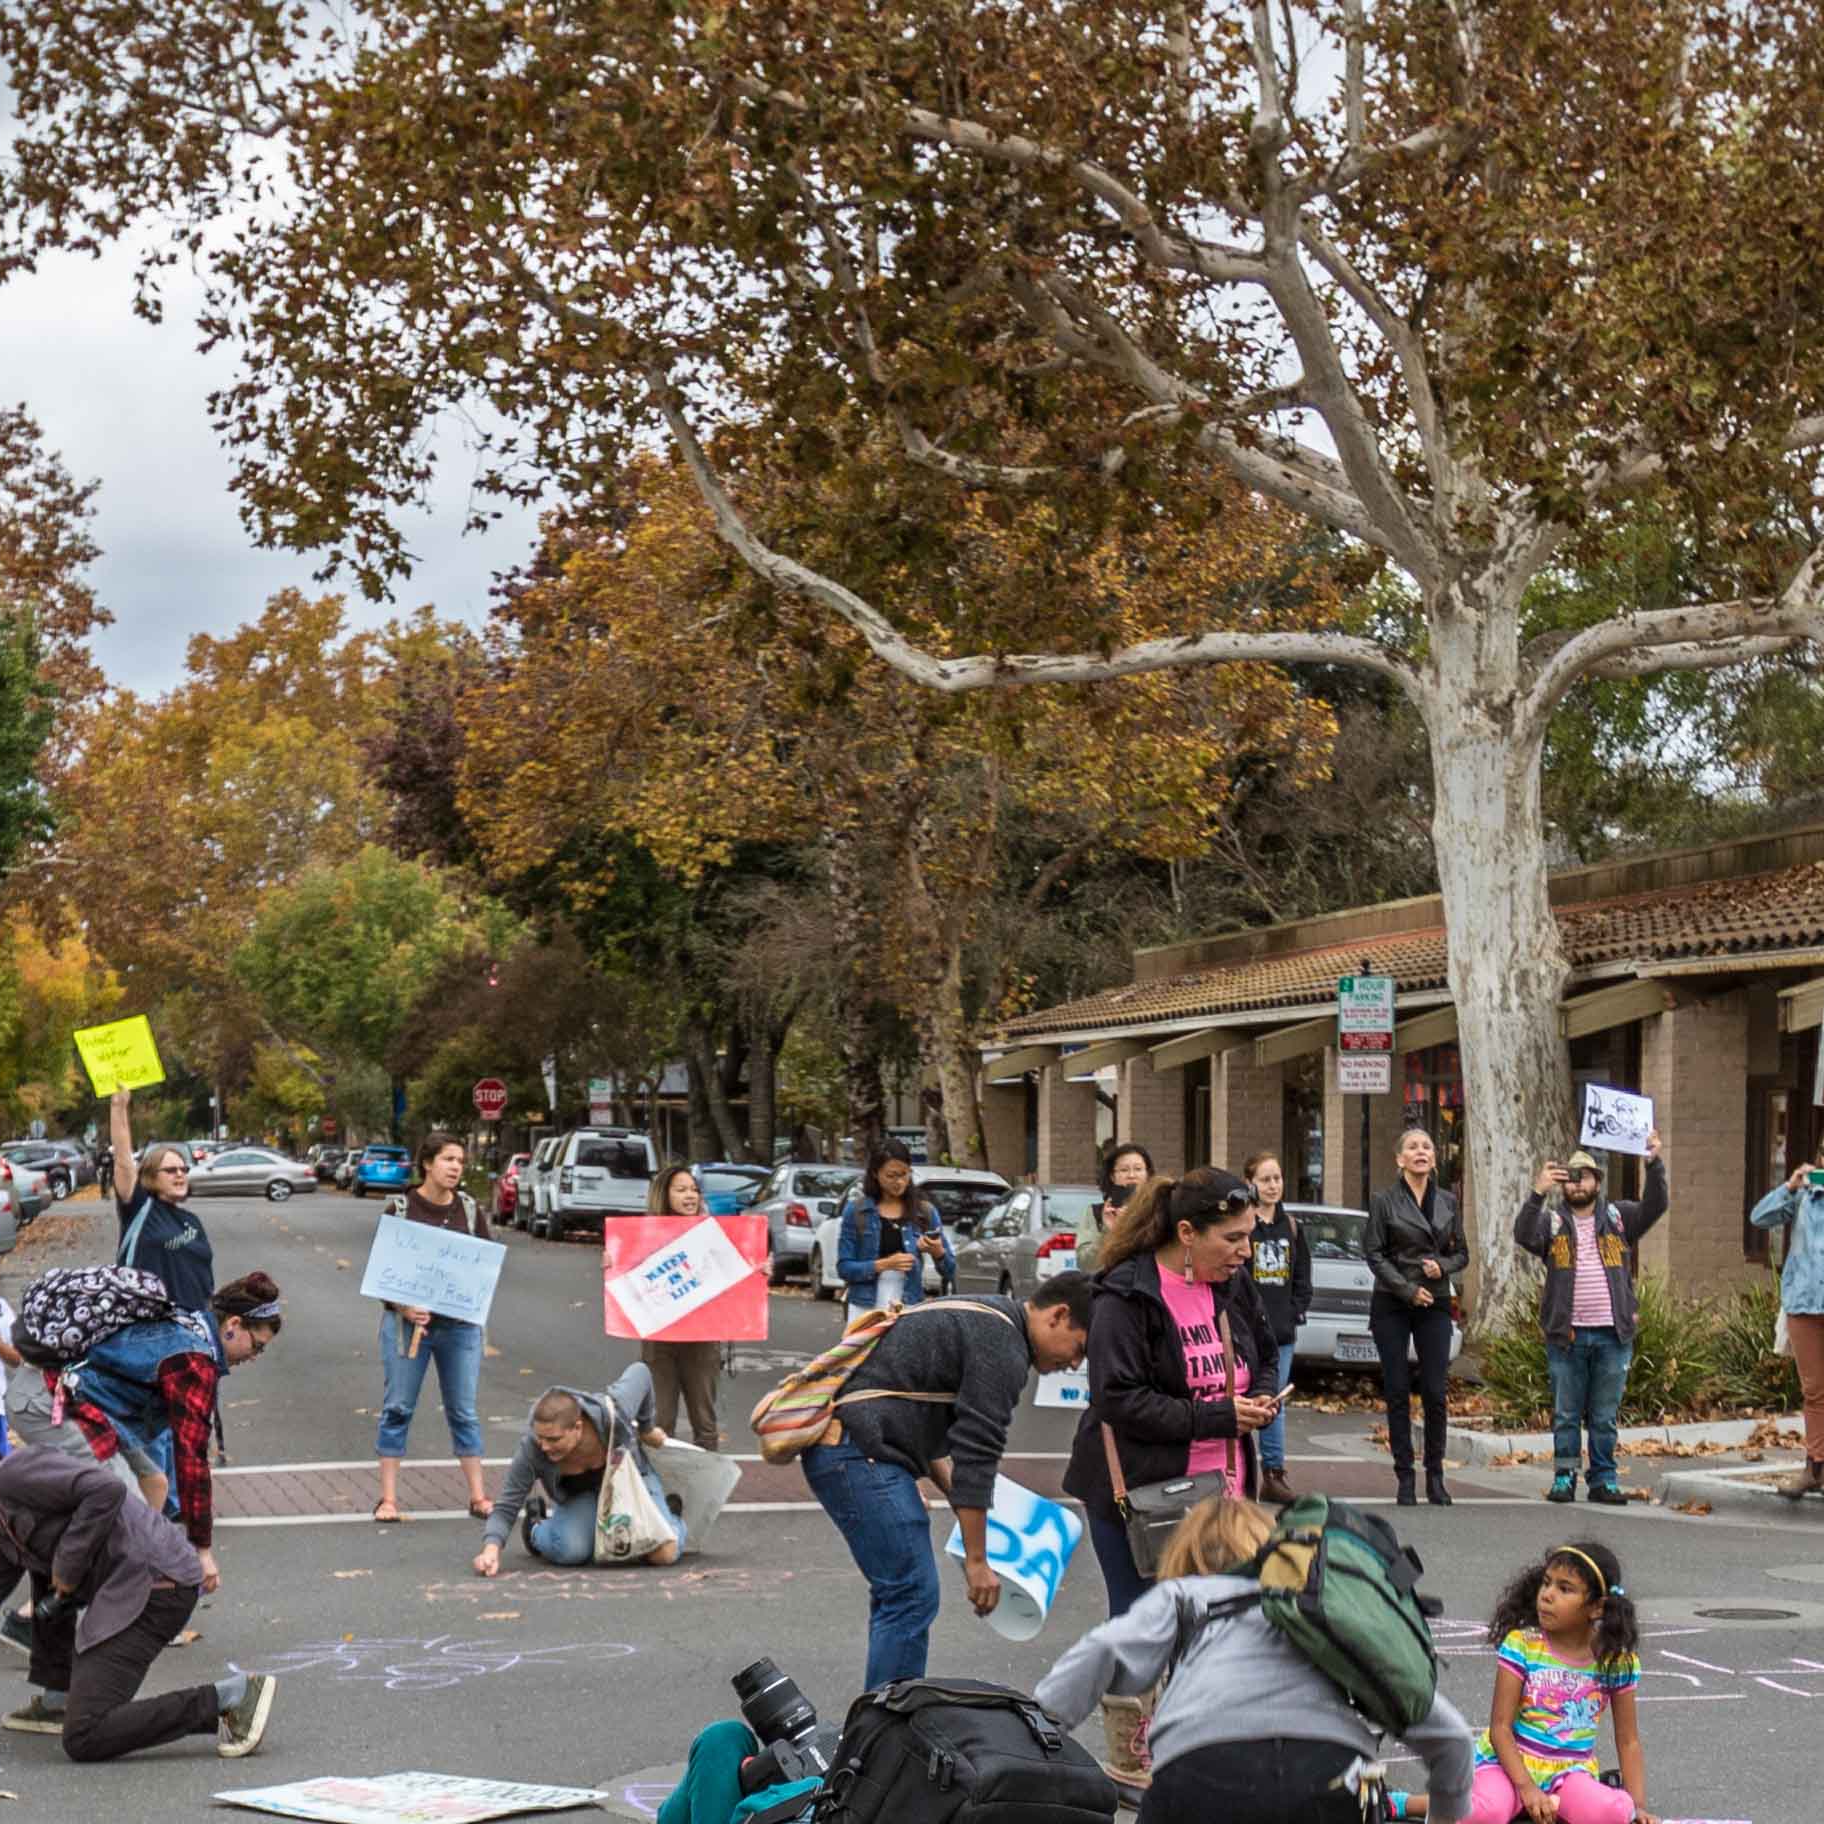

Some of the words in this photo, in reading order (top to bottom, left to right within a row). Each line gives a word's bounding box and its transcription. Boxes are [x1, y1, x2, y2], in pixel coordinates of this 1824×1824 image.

[476, 1089, 506, 1102] STOP
[646, 1251, 688, 1281] WATER
[671, 1278, 701, 1301] LIFE
